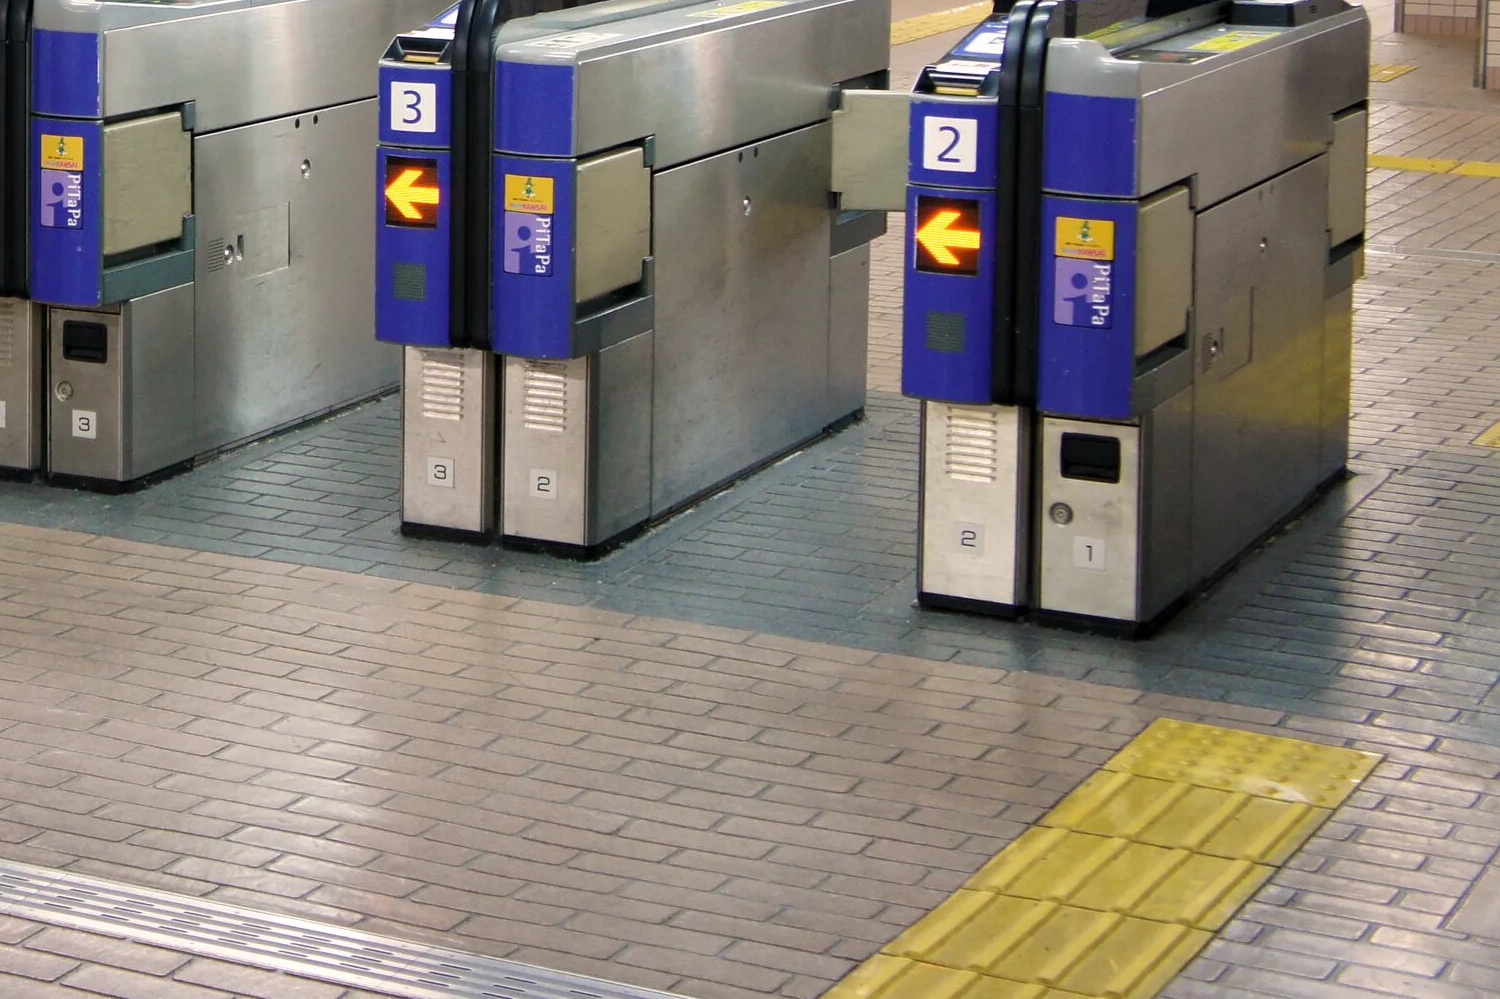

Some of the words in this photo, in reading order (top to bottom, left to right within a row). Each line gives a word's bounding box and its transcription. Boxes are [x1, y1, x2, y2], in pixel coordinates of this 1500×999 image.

[402, 91, 421, 123] 3
[937, 126, 962, 162] 2
[68, 174, 81, 226] PiTaPa
[535, 218, 551, 273] PiTaPa
[1092, 264, 1111, 325] PiTaPa
[78, 417, 90, 431] 3
[434, 464, 446, 480] 3
[537, 477, 550, 493] 2
[961, 529, 976, 547] 2
[1085, 543, 1095, 561] 1
